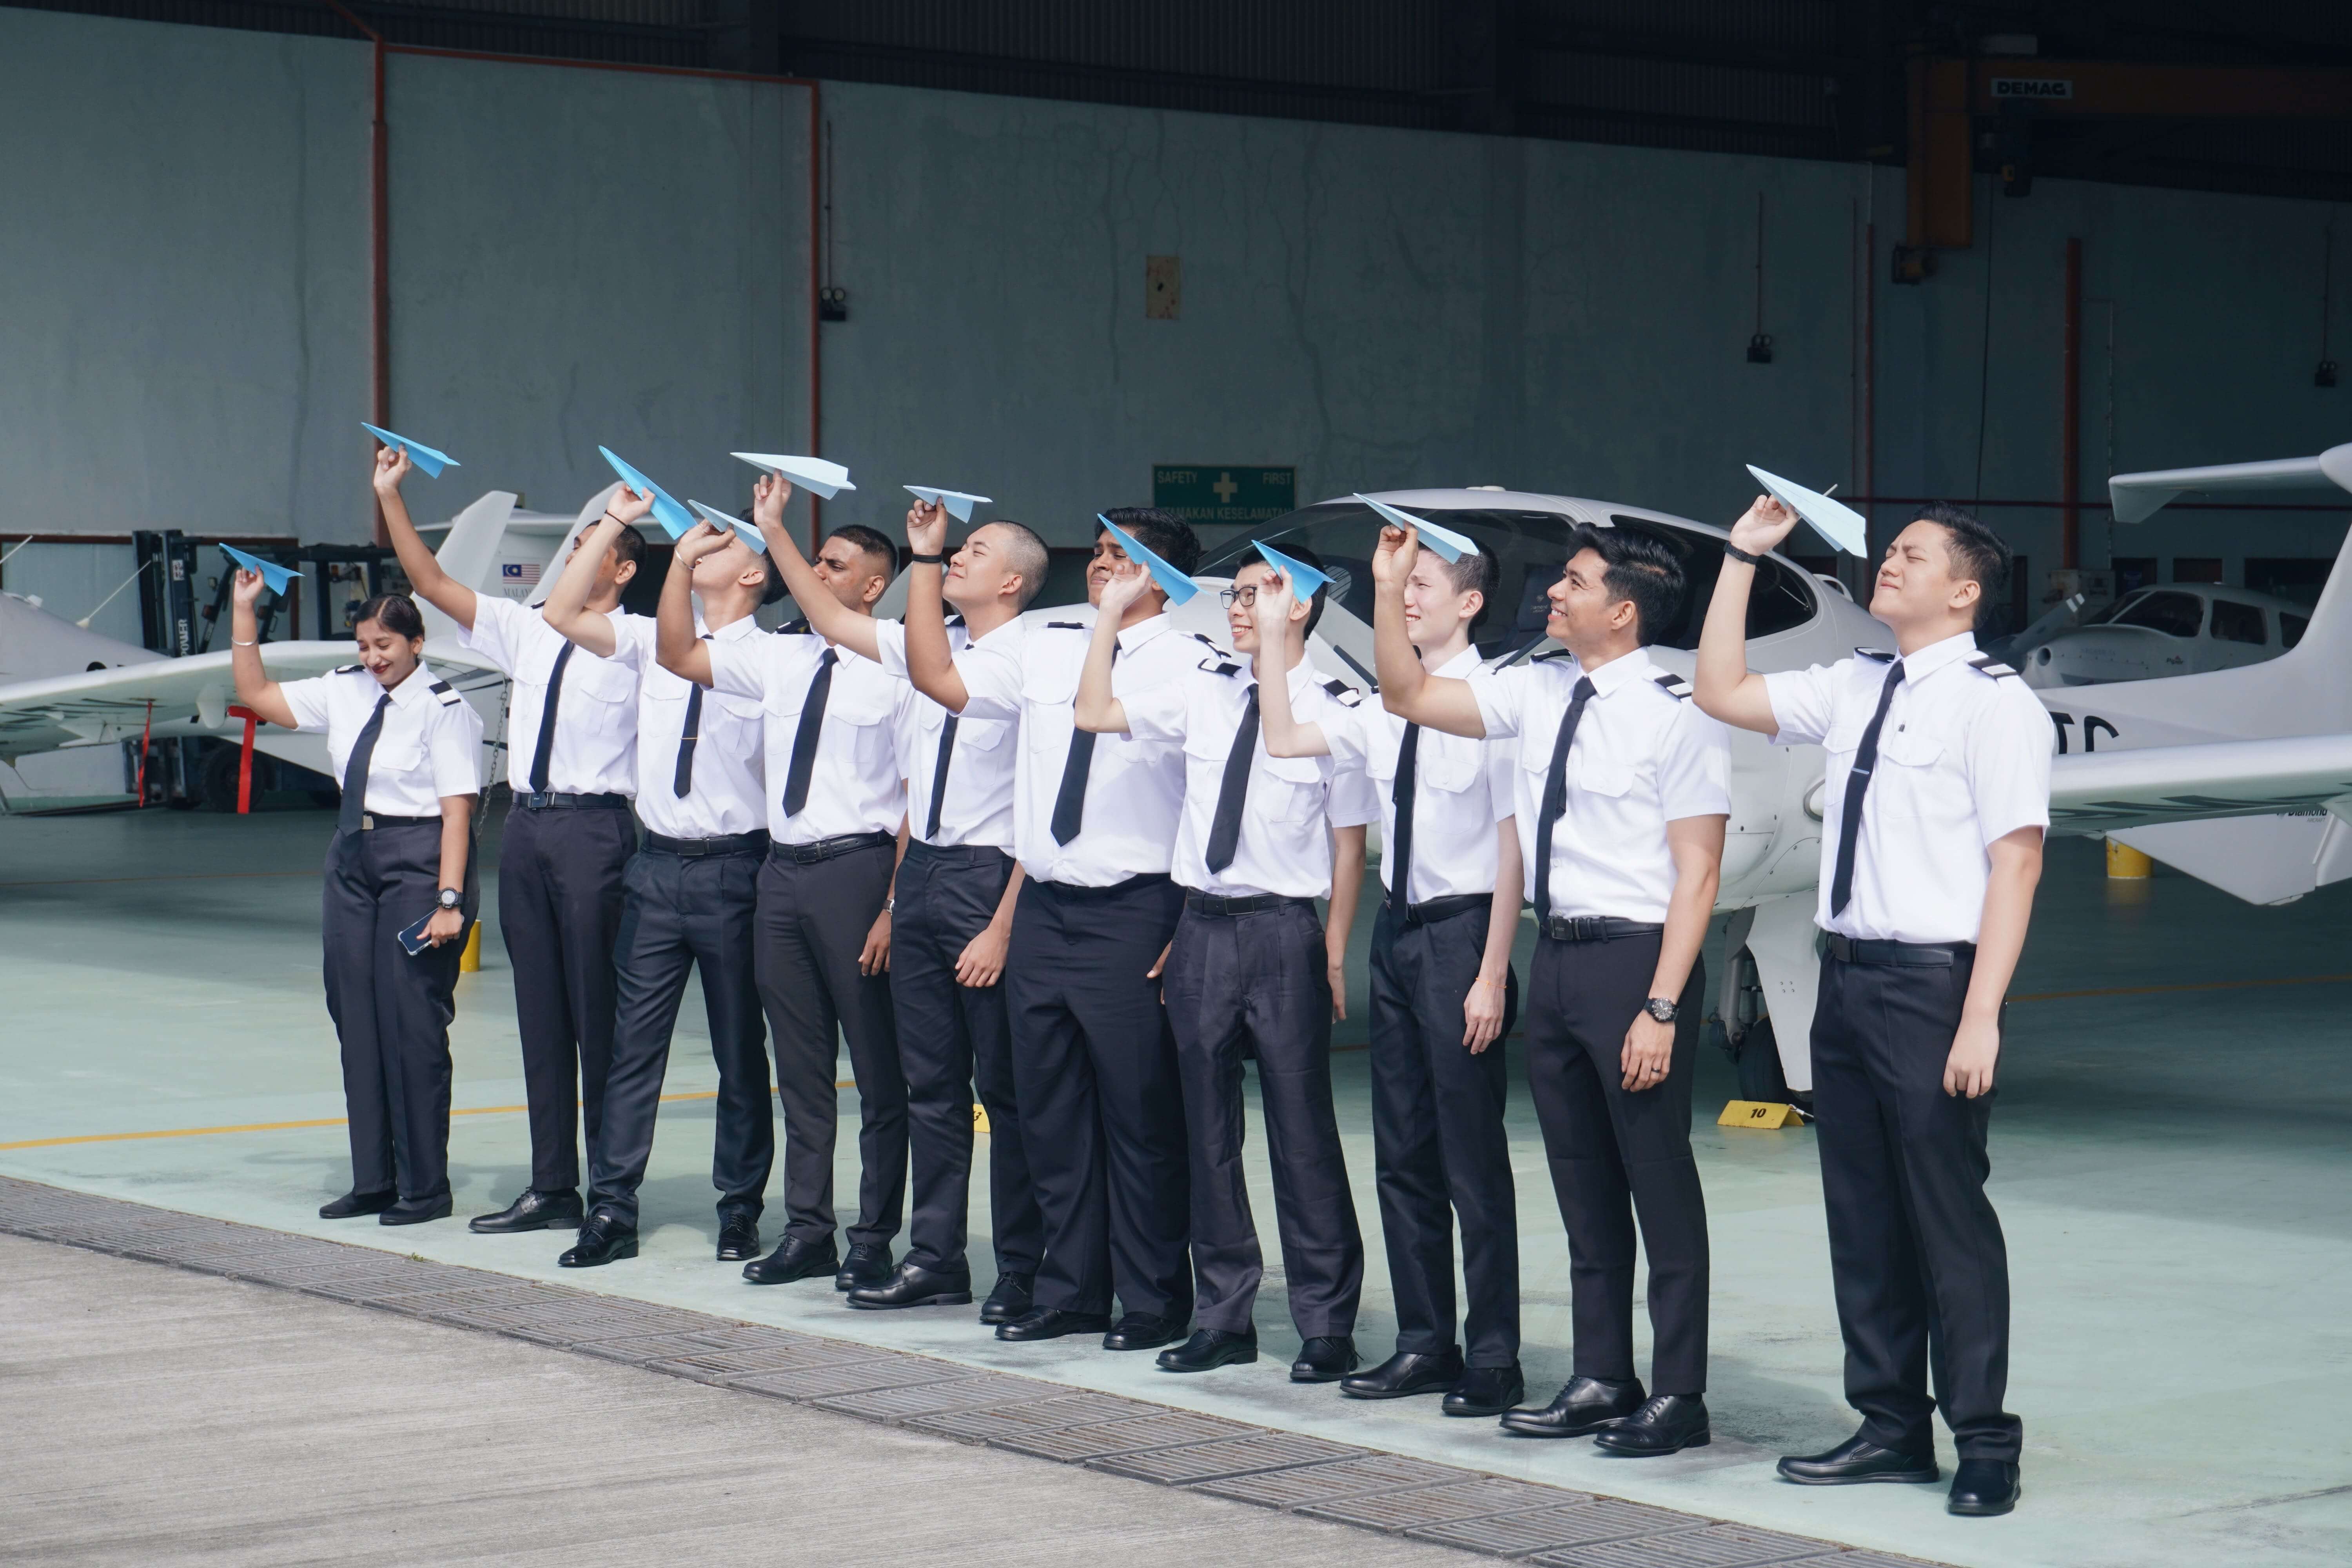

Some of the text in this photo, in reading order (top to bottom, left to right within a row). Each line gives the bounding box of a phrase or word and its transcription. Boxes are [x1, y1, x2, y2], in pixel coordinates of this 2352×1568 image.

[1997, 81, 2065, 95] DEMAG
[1157, 470, 1292, 485] SAFETY FIRST
[1750, 1108, 1767, 1118] 10
